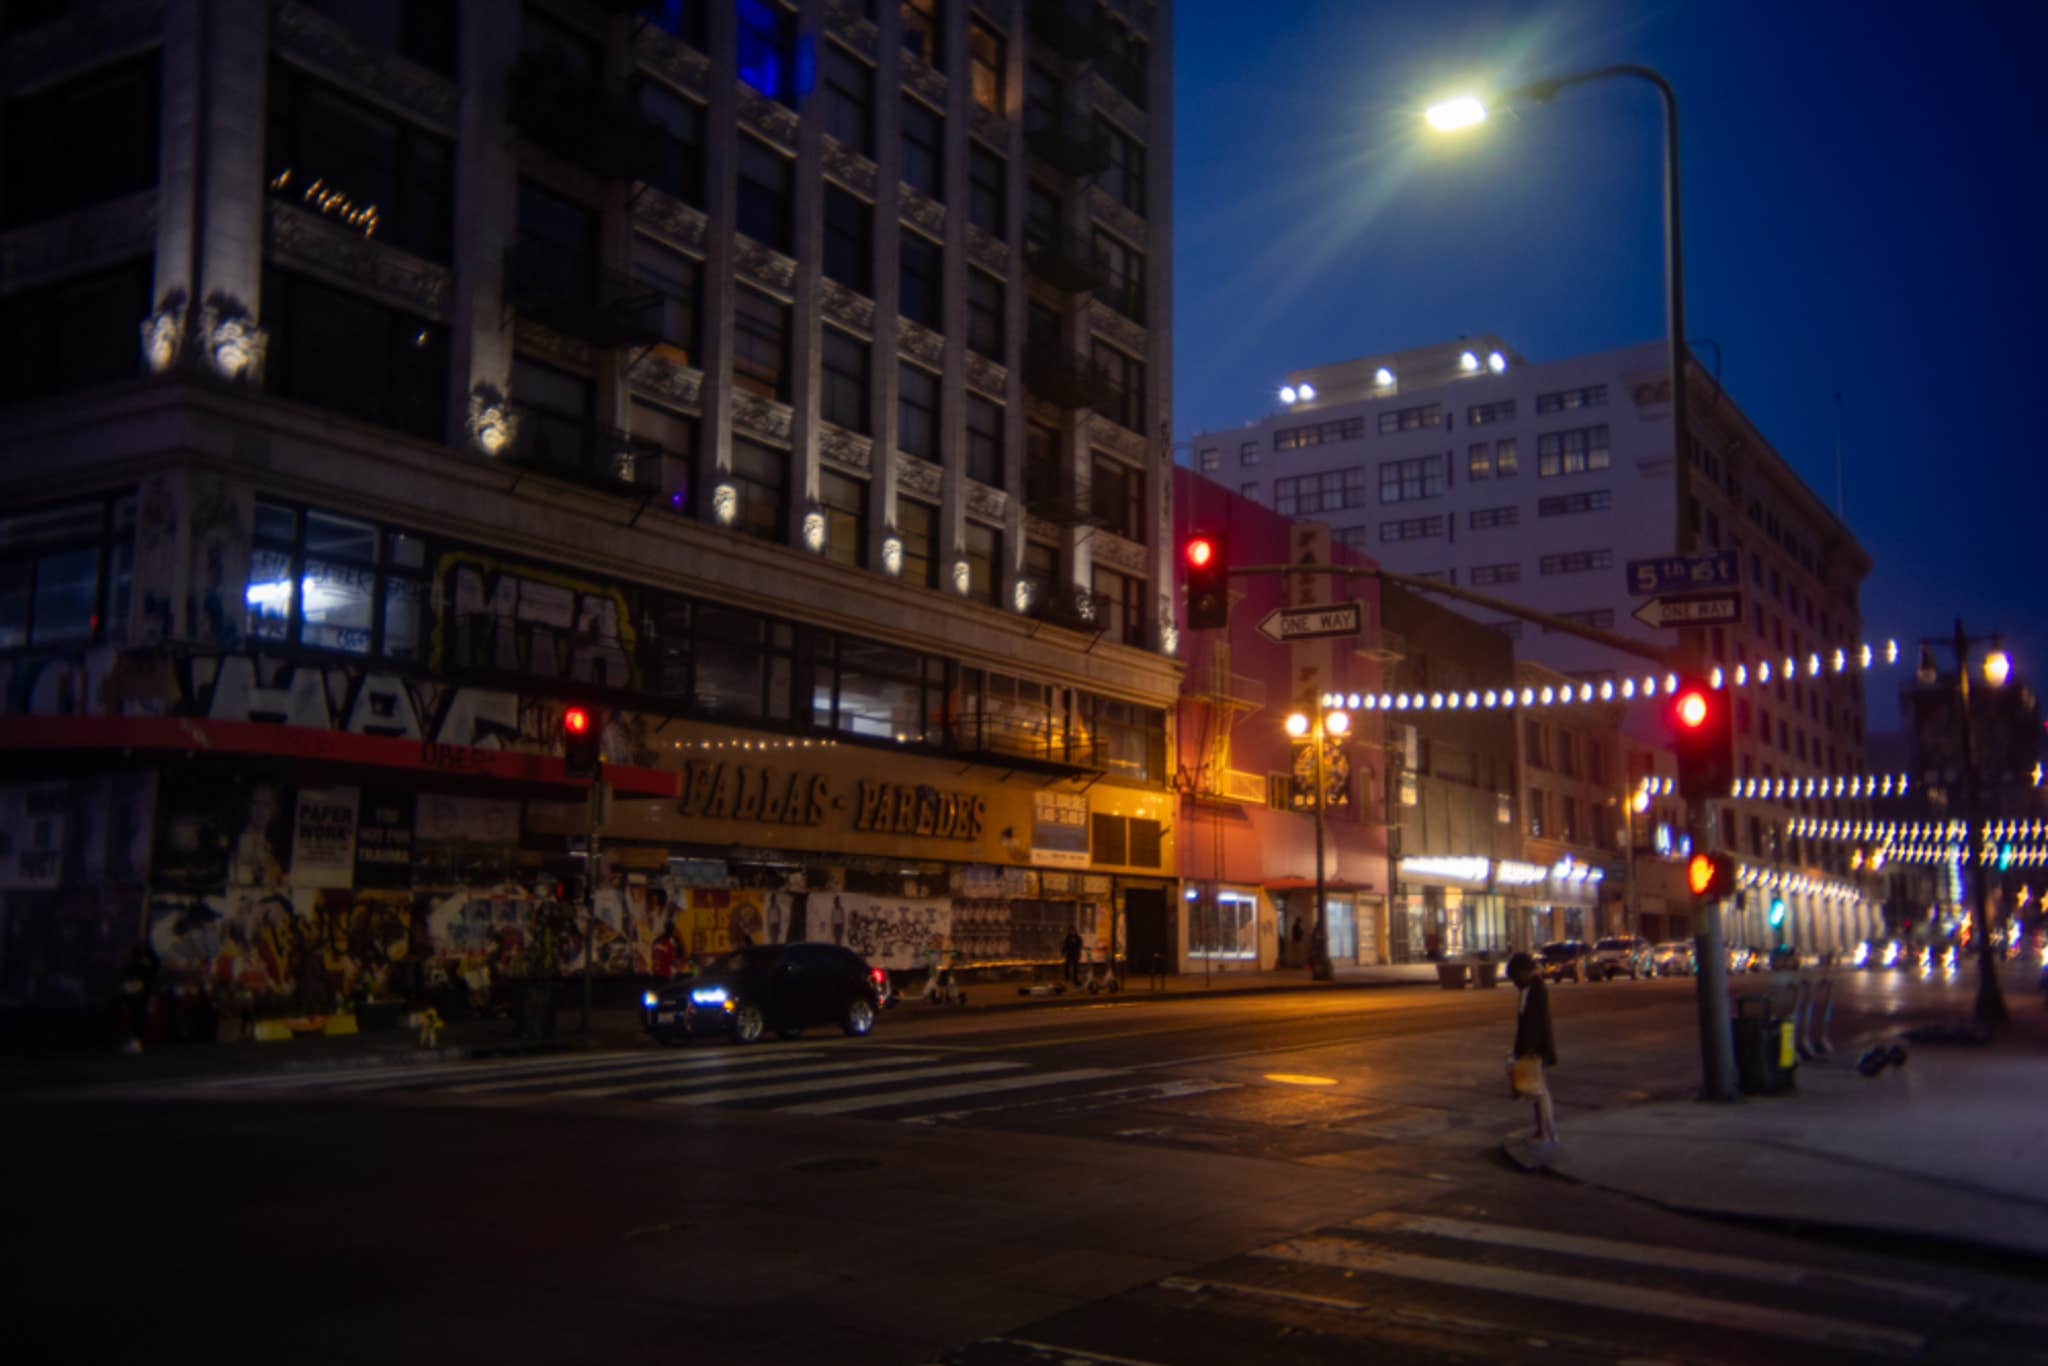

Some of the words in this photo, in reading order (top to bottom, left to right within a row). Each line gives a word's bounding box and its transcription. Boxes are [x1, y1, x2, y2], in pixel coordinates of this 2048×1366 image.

[1636, 560, 1686, 591] 5th
[1281, 613, 1312, 634] ONE
[1320, 607, 1351, 632] WAY
[1661, 602, 1691, 620] ONE
[1697, 598, 1730, 618] WAY
[679, 758, 829, 826] FALLAS
[299, 802, 353, 824] PAPER
